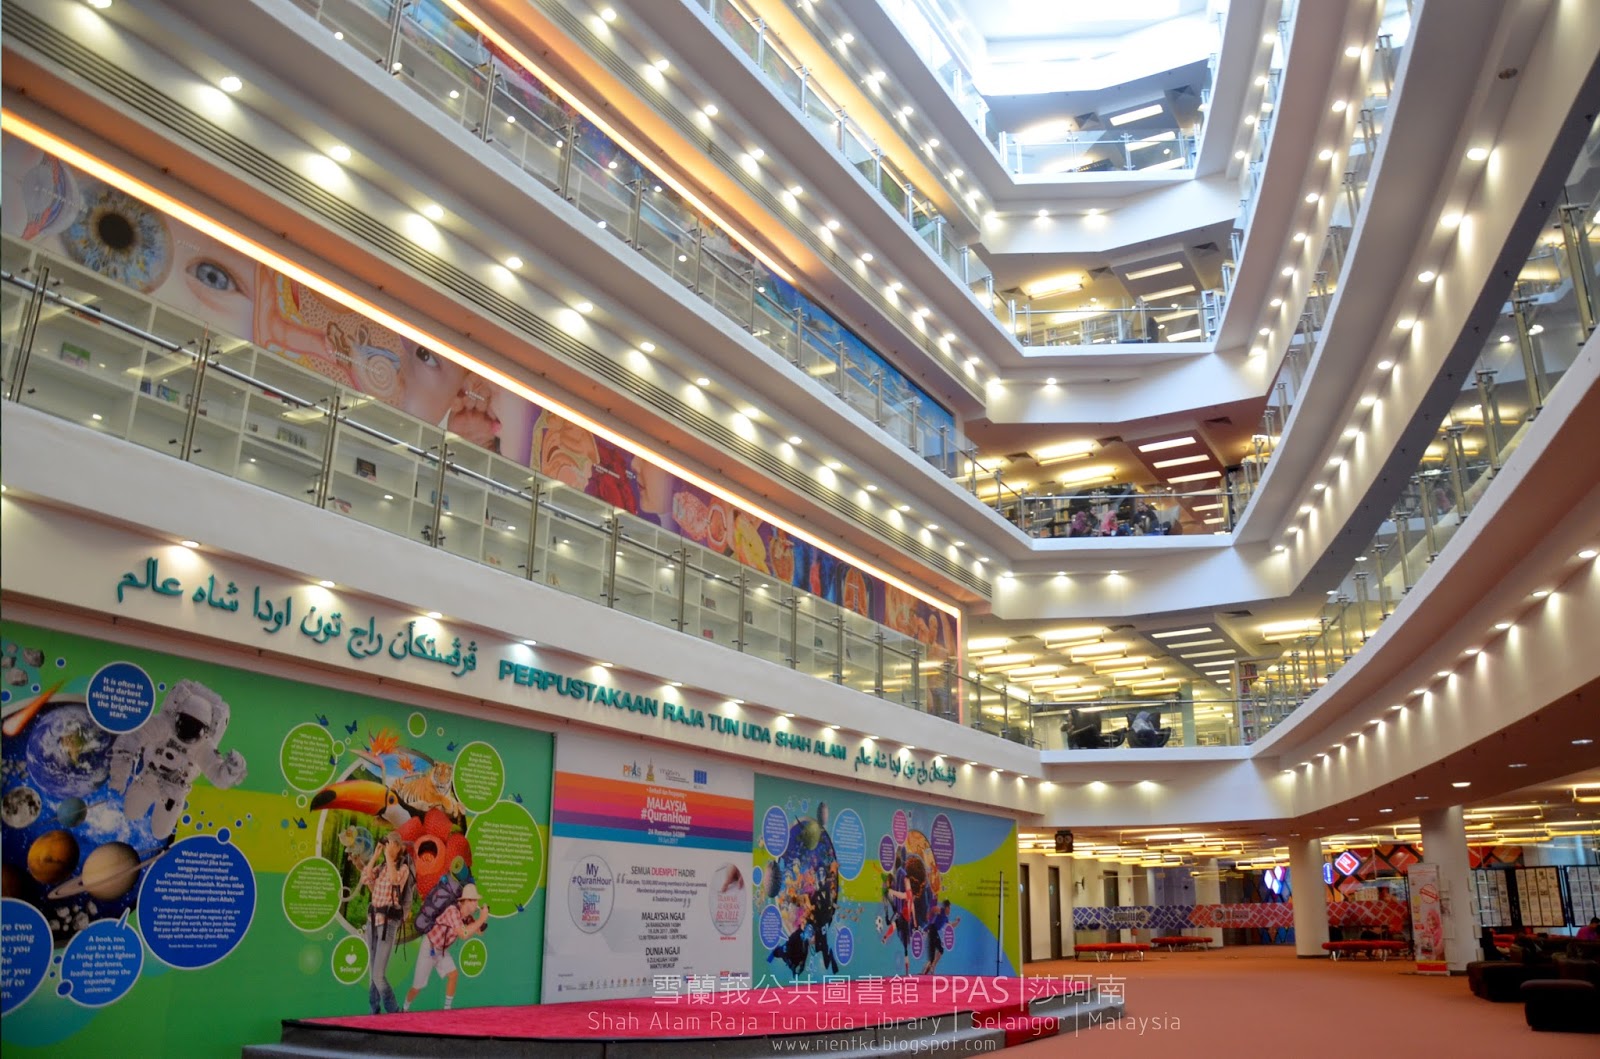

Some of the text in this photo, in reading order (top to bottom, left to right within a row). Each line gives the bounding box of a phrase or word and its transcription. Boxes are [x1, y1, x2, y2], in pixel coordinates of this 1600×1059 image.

[117, 556, 184, 603] عالم
[118, 680, 136, 688] often
[92, 692, 109, 700] skies
[116, 688, 141, 698] darkest
[98, 700, 141, 713] the brightest
[499, 659, 847, 760] PERPUSTAKAAN RAJA TUN UDA SHAH ALAM
[647, 796, 688, 814] MALAYSIA
[641, 808, 692, 825] #QuranHour
[586, 863, 599, 878] My
[631, 866, 650, 876] SEMUA
[572, 875, 612, 887] #QuranHour
[642, 912, 686, 920] MALAYSIA NGAJI
[14, 923, 32, 931] two
[13, 946, 30, 955] you
[646, 946, 680, 956] DUNIA NGAJI
[14, 967, 32, 978] you
[14, 979, 25, 987] to
